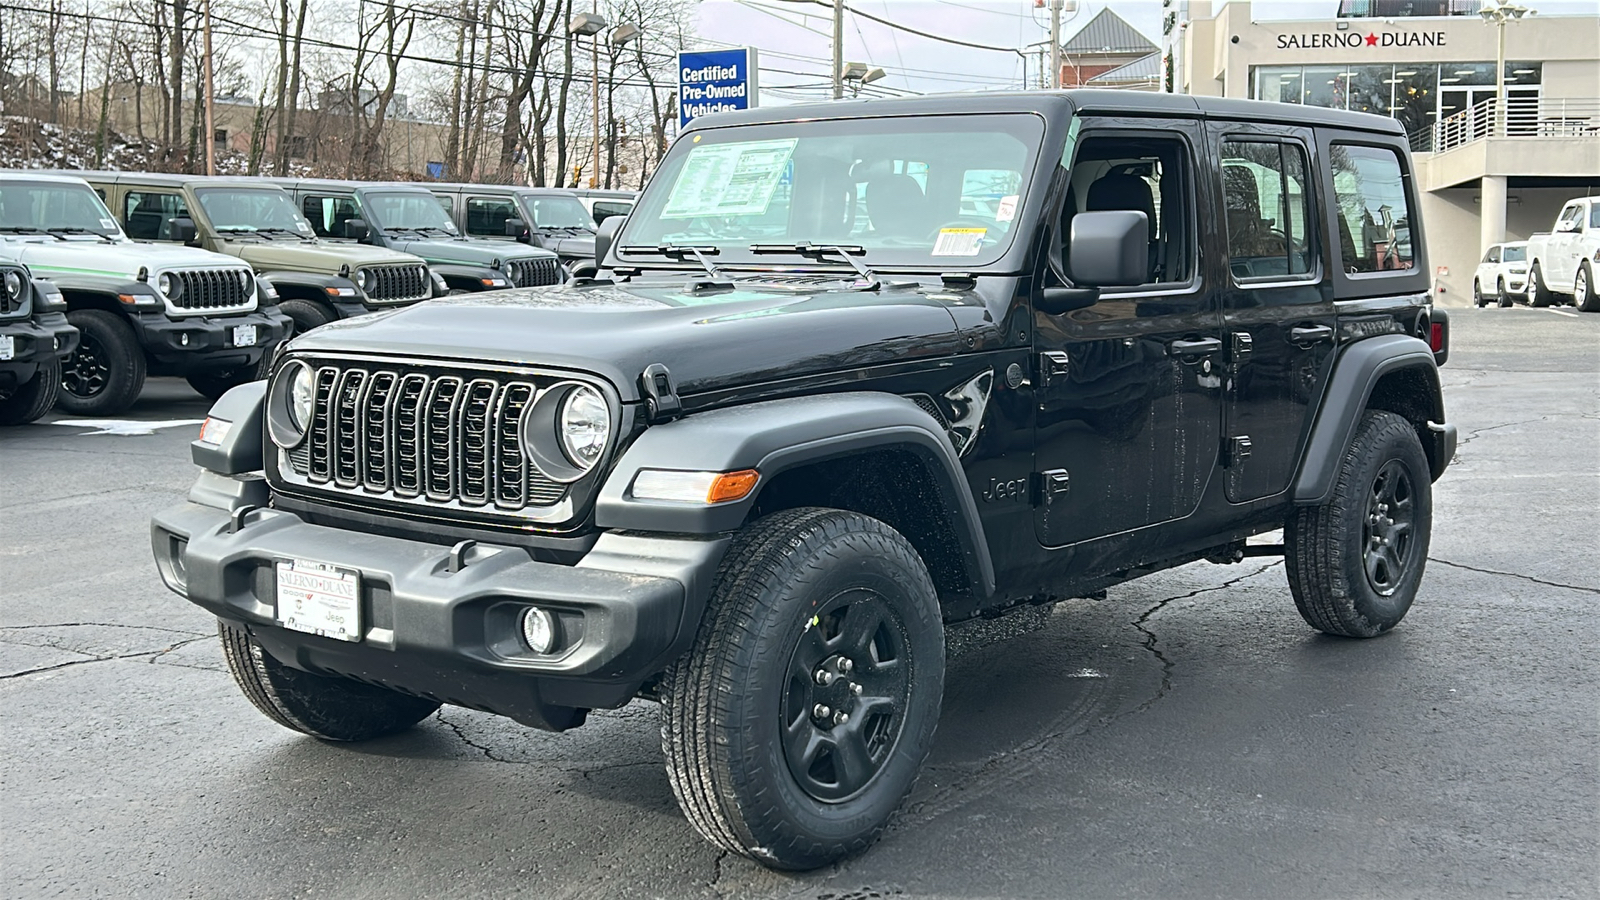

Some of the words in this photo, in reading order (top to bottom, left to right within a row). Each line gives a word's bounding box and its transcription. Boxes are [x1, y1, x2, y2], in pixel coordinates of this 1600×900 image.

[1276, 32, 1363, 49] SALERNO
[1381, 31, 1447, 47] DUANE
[682, 65, 737, 82] Certified
[682, 82, 746, 100] Pre-Owned
[982, 477, 1026, 503] Jeep
[279, 572, 318, 589] SALERNO
[323, 580, 354, 596] DUANE
[325, 611, 345, 624] Jeep
